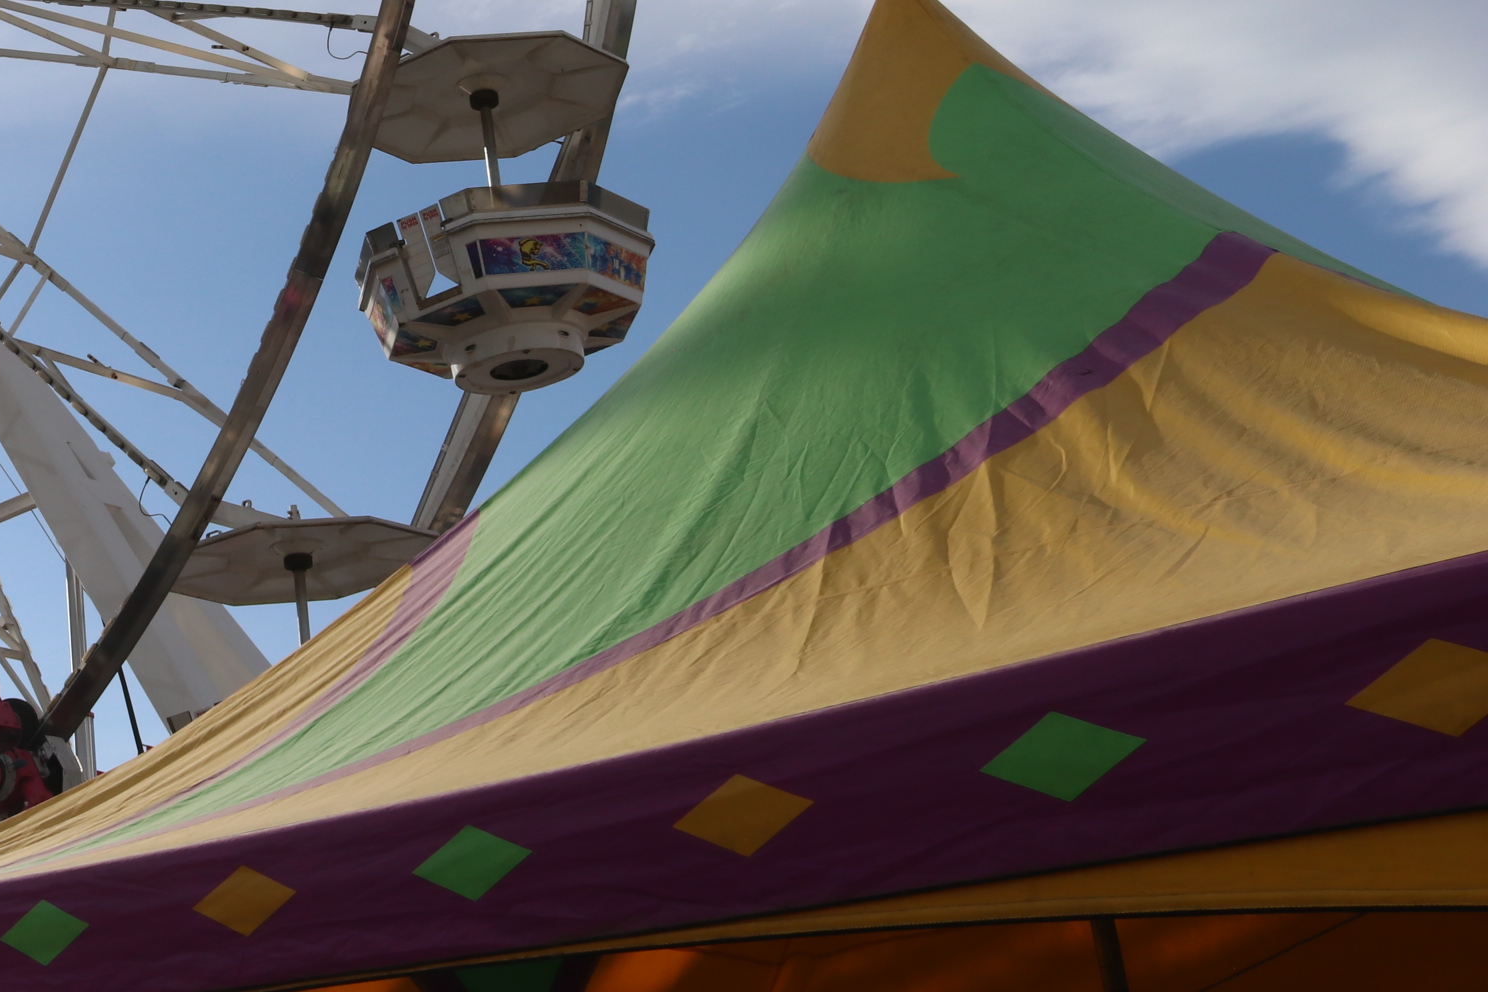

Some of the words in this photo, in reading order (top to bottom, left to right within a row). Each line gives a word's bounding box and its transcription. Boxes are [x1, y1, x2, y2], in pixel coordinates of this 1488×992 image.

[423, 208, 437, 218] PUSH
[401, 216, 416, 227] PUSH
[407, 220, 419, 228] OPEN
